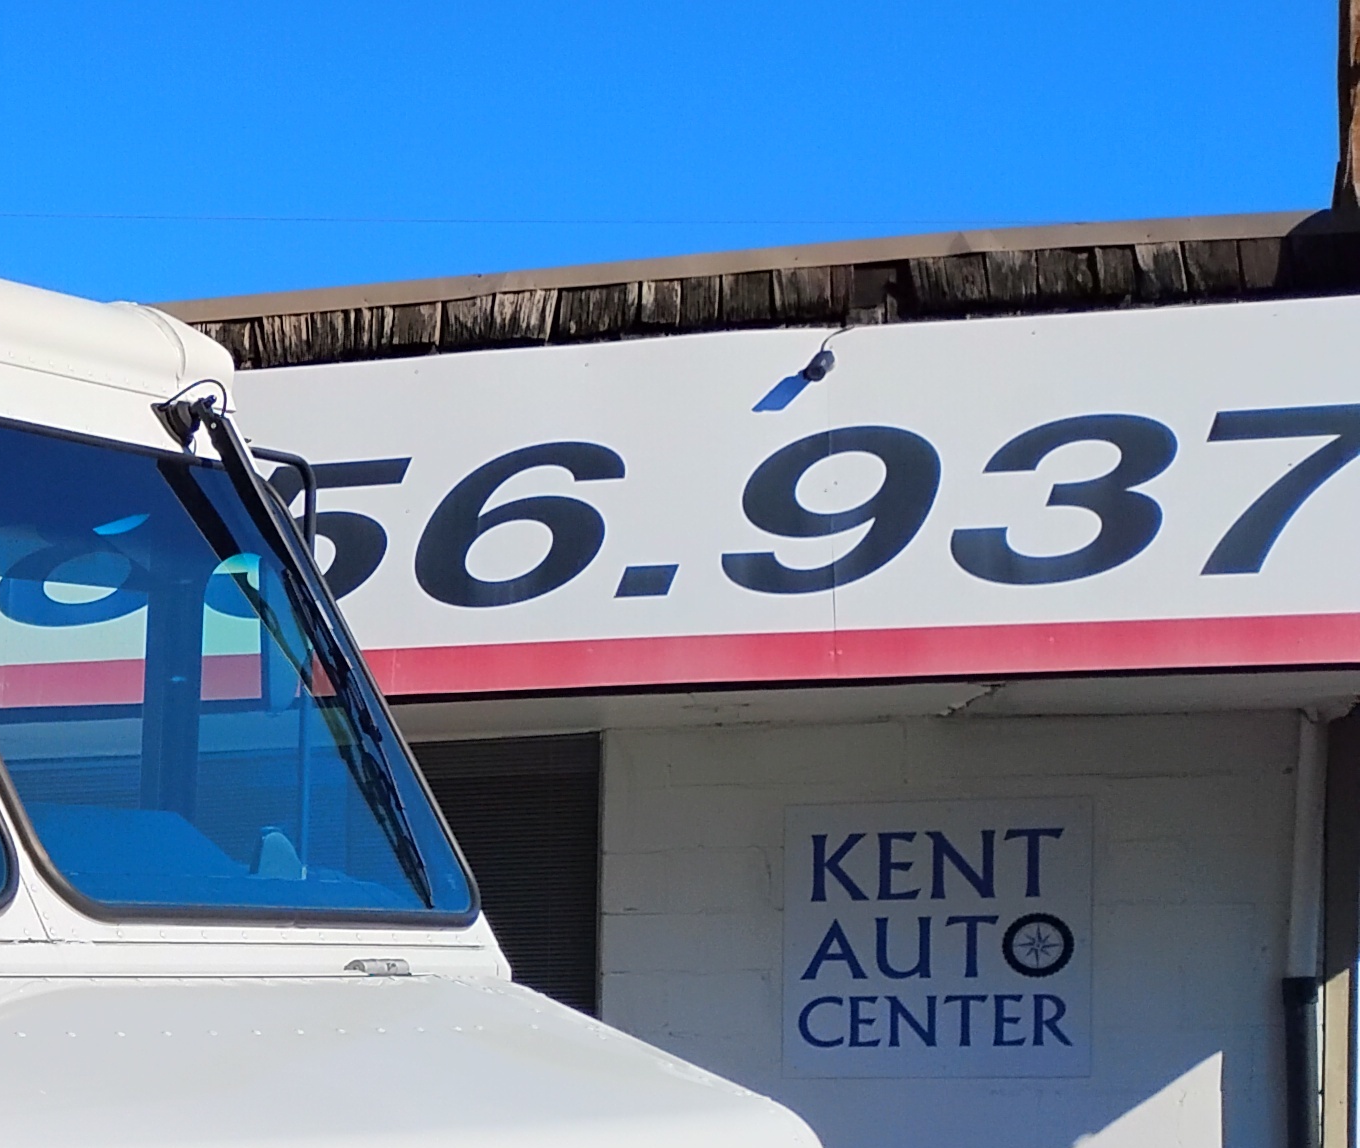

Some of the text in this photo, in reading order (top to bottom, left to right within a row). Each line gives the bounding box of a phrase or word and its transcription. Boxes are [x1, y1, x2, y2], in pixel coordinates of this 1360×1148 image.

[810, 827, 1065, 902] KENT
[799, 912, 1075, 981] AUTO
[797, 993, 1073, 1049] CENTER
